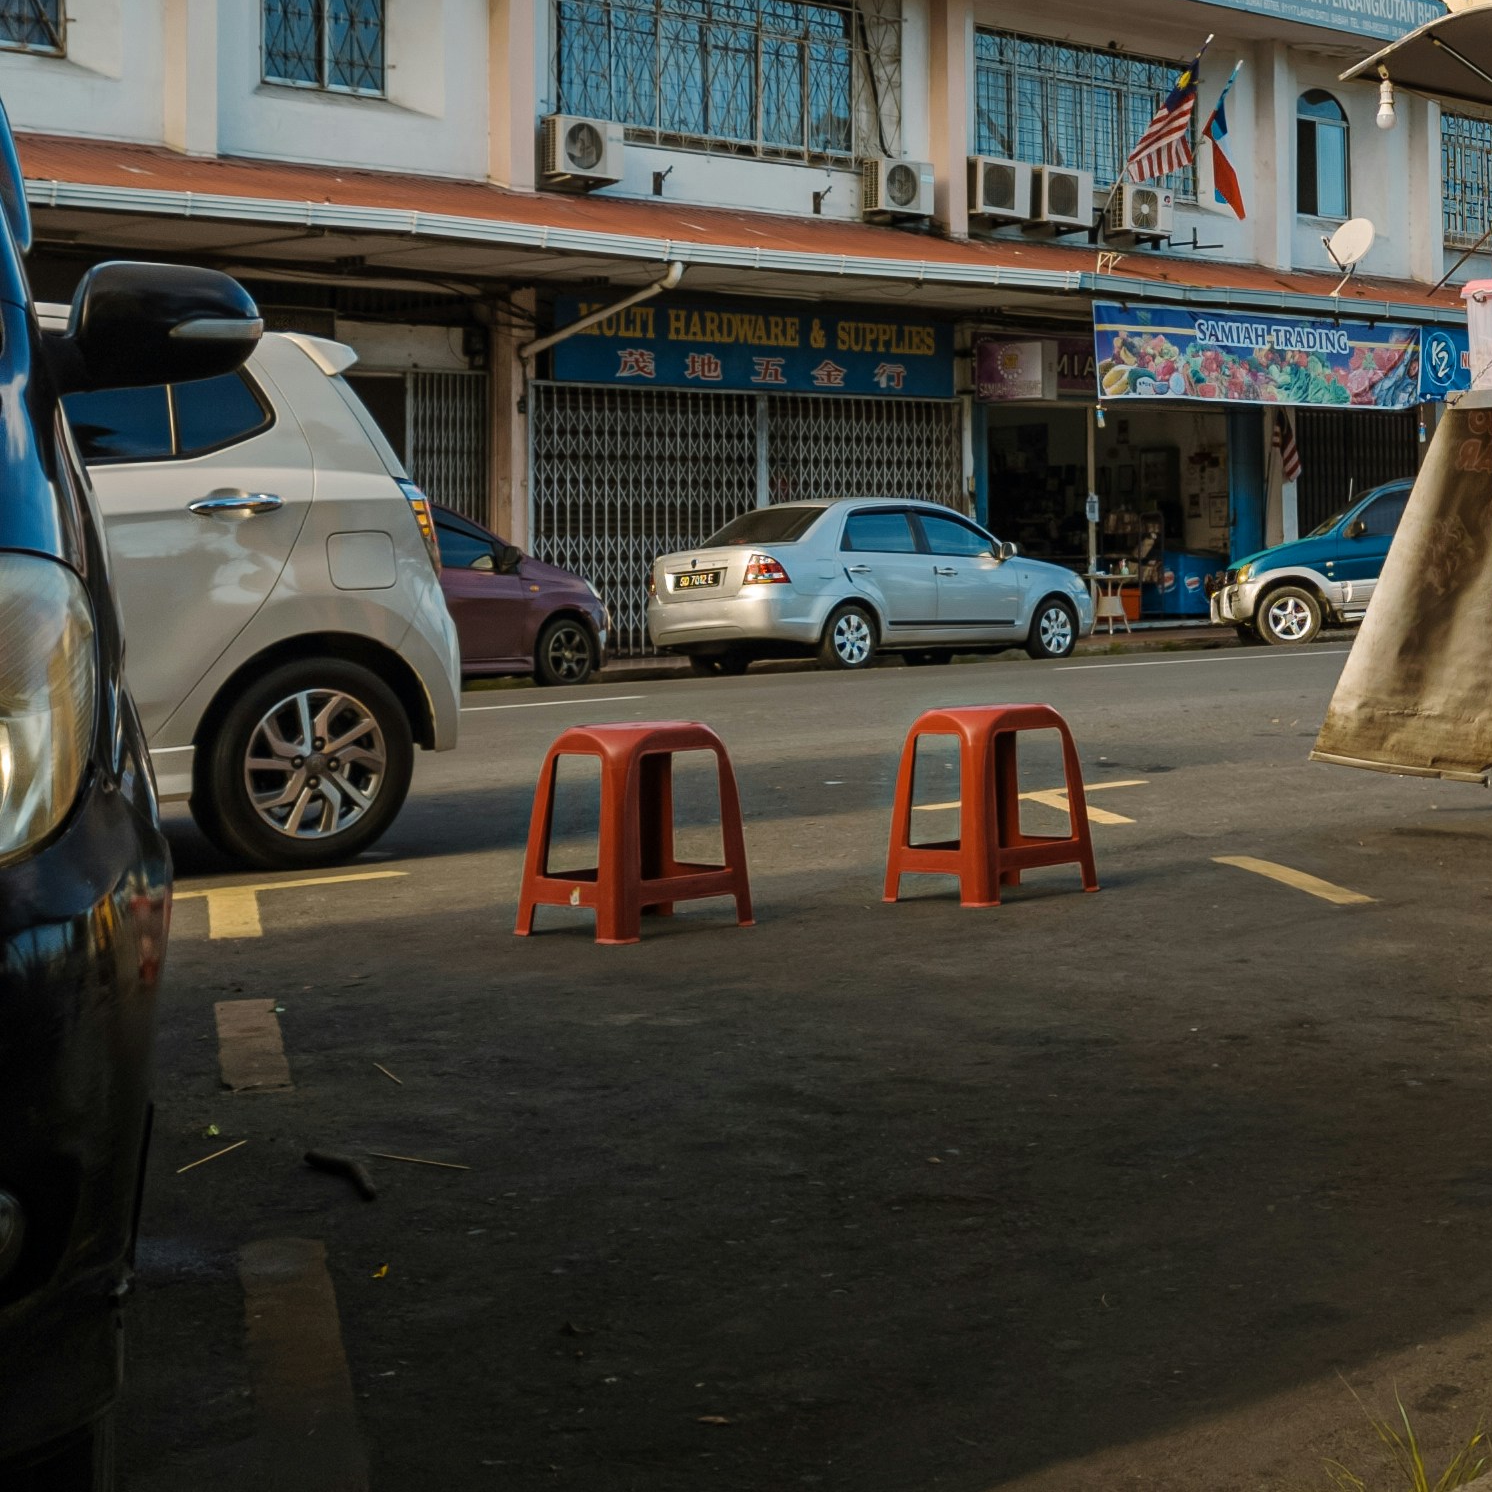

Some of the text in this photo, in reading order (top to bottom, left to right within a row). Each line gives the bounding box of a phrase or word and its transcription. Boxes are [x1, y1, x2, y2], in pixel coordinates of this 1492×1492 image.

[1418, 2, 1440, 25] BHD
[668, 308, 799, 347] HARDWARE
[810, 318, 826, 349] &
[837, 321, 935, 356] SUPPLIES
[1195, 319, 1349, 354] SAMIAH TRADING
[616, 349, 907, 389] 茂地五金行
